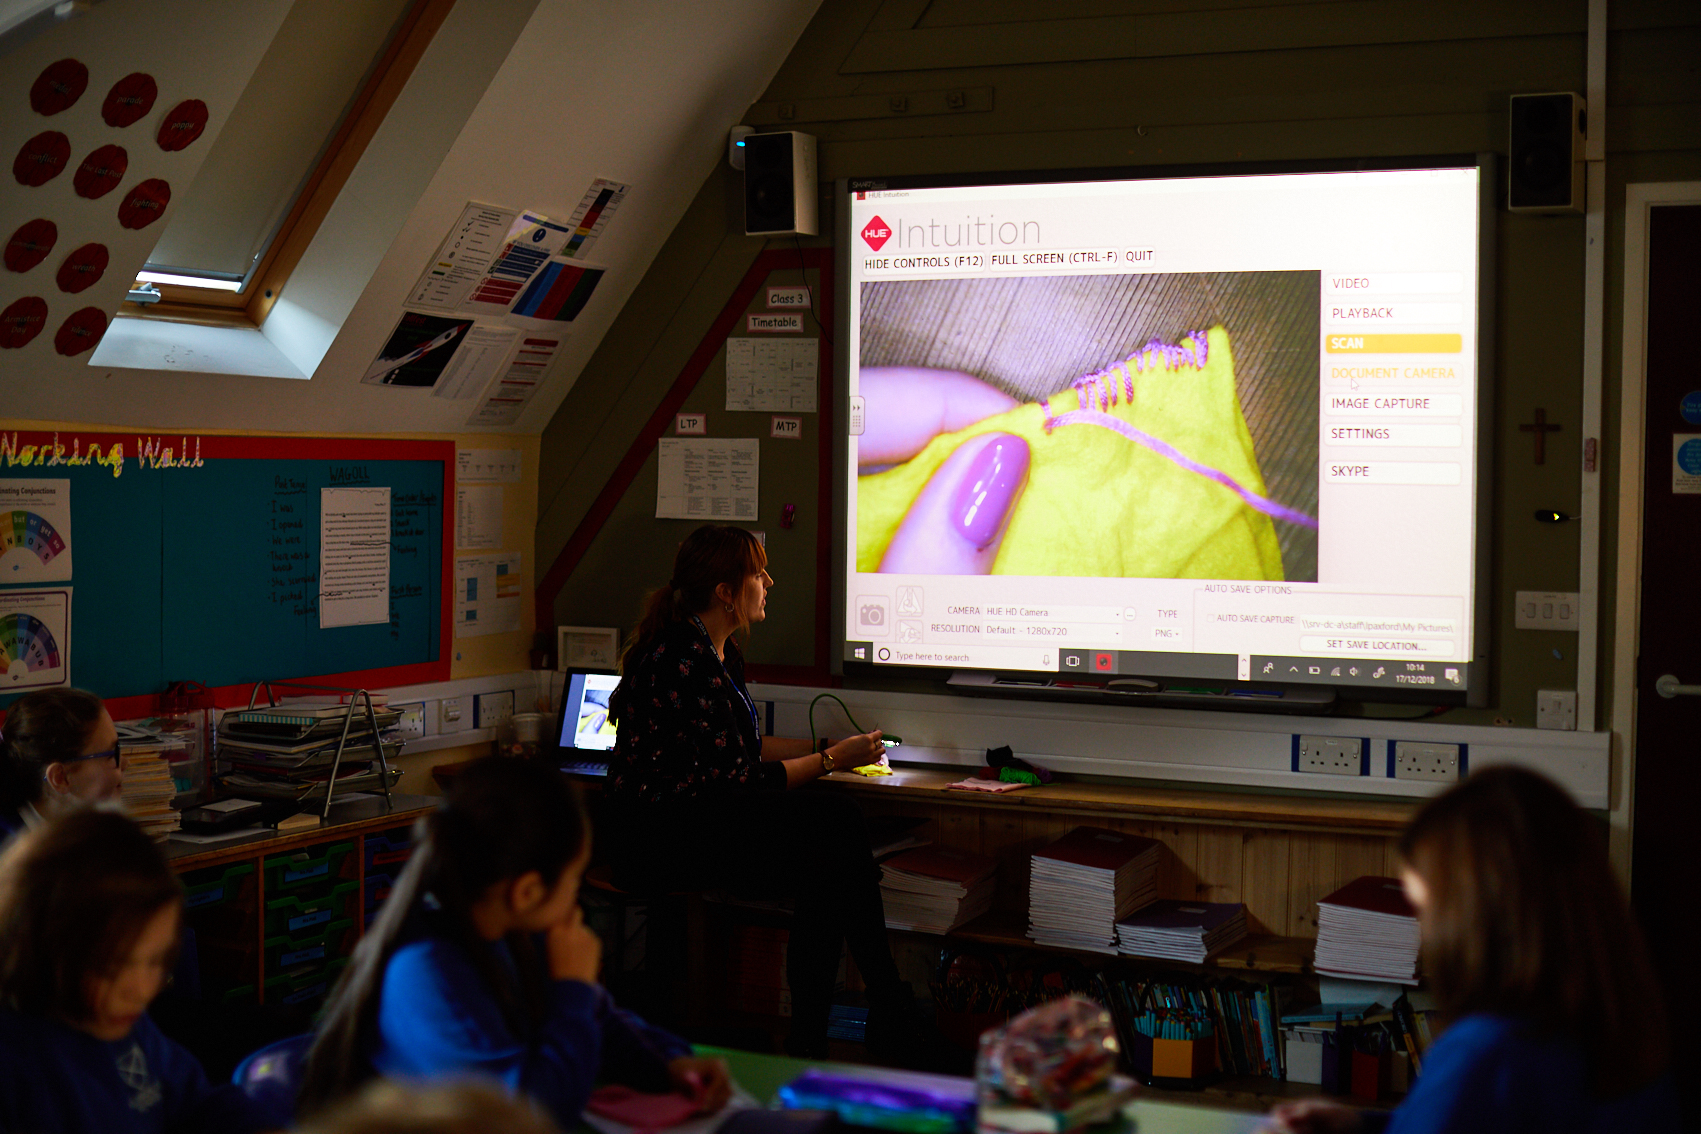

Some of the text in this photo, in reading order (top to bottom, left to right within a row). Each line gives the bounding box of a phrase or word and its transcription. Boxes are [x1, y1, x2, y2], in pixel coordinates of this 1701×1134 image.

[116, 95, 144, 106] parade
[171, 121, 195, 131] poppy
[28, 153, 58, 165] conflict
[82, 163, 123, 179] The Last Post
[883, 190, 910, 198] Intuition
[130, 198, 160, 210] fighting
[864, 214, 1041, 249] HUE Intuition
[991, 251, 1118, 265] FULL SCREEN (CTRL-F)
[1125, 250, 1153, 262] QUIT
[864, 255, 984, 269] HIDE CONTROLS (F12)
[72, 263, 96, 273] wreath
[1332, 278, 1369, 289] VIDEO
[771, 293, 804, 304] Class 3
[1332, 307, 1394, 318] PLAYBACK
[4, 315, 41, 323] Armistice
[751, 316, 798, 328] Timetable
[11, 326, 27, 336] Day
[1331, 337, 1364, 349] SCAN
[1331, 367, 1456, 379] DOCUMENT CAMERA
[1332, 398, 1430, 409] IMAGE CAPTURE
[680, 419, 698, 429] LTP
[775, 420, 797, 431] MTP
[1331, 428, 1390, 439] SETTINGS
[137, 436, 205, 470] Wall
[329, 465, 370, 482] WAGOLL
[1331, 465, 1369, 477] SKYPE
[21, 487, 56, 496] Conjunctions
[280, 504, 294, 513] was
[14, 515, 26, 524] but
[40, 525, 52, 538] yet
[53, 539, 60, 550] so
[1204, 584, 1292, 595] AUTO SAVE OPTIONS
[280, 590, 303, 606] picked
[947, 606, 1049, 617] CAMERA HUE HD Camera
[1157, 609, 1178, 619] TYPE
[1216, 614, 1295, 624] AUTO SAVE CAPTURE
[931, 624, 981, 634] RESOLUTION
[986, 625, 1016, 635] Default
[1026, 626, 1067, 636] 1280x720
[1155, 629, 1172, 638] PNG
[1326, 639, 1427, 651] SET SAVE LOCATION...
[895, 651, 969, 663] Type here to search
[1406, 663, 1425, 671] 10:14
[1396, 674, 1435, 685] 17/12/2018
